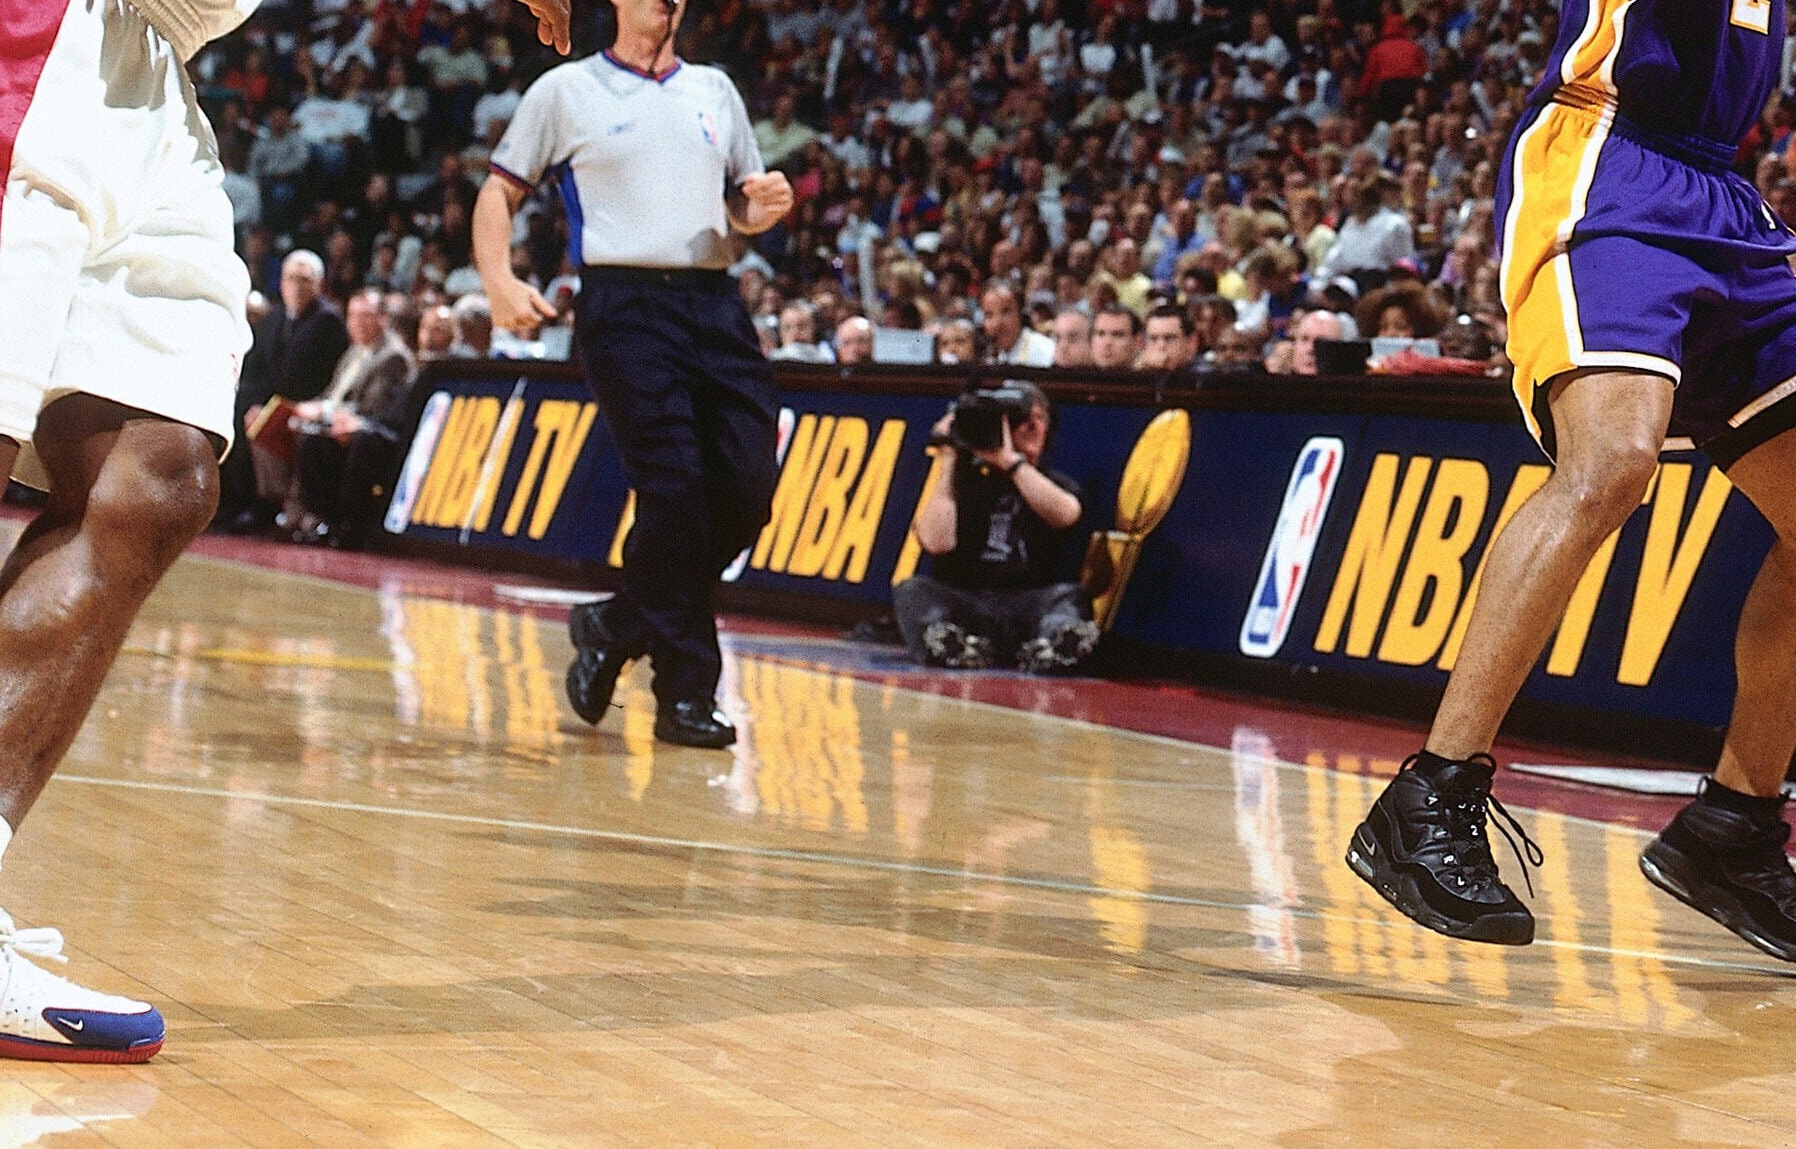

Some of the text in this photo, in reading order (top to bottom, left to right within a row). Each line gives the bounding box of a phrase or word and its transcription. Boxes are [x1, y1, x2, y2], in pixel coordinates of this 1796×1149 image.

[412, 395, 600, 542] NBA TV
[752, 413, 907, 583] NBA
